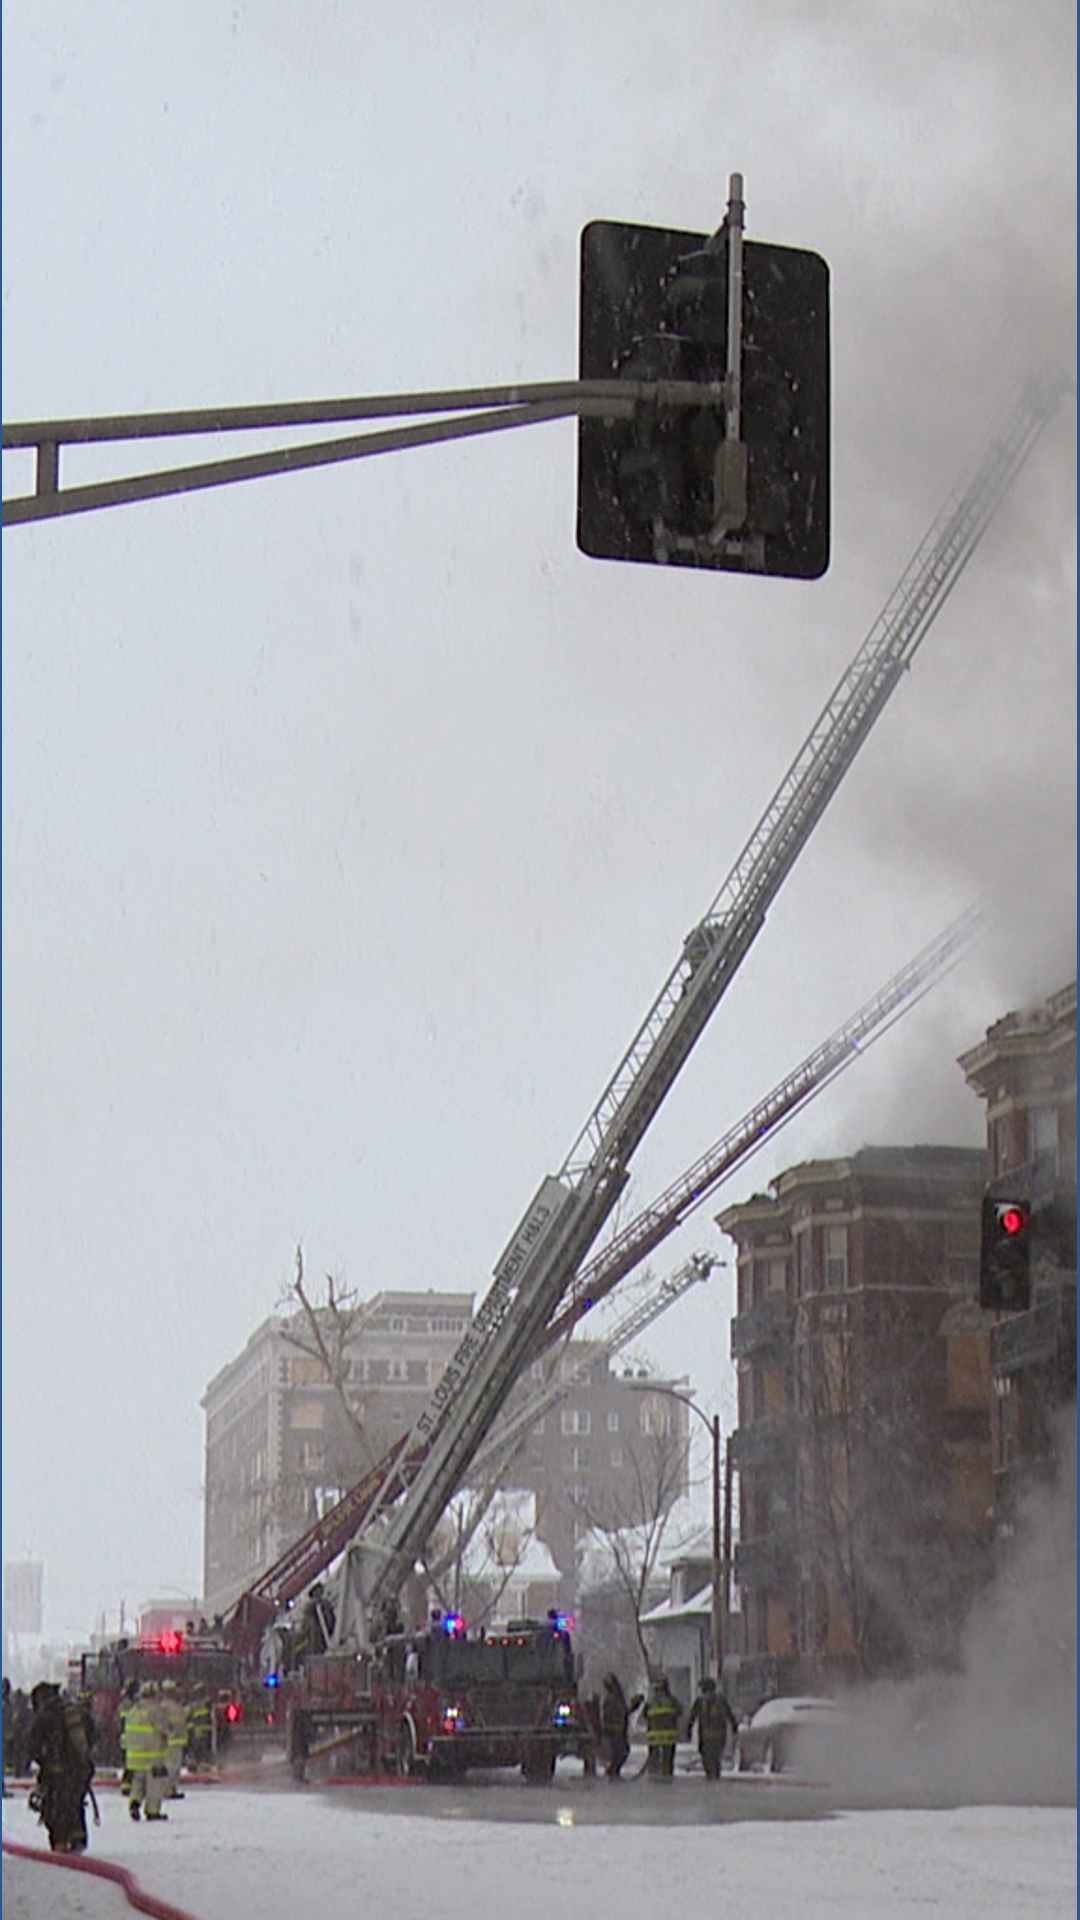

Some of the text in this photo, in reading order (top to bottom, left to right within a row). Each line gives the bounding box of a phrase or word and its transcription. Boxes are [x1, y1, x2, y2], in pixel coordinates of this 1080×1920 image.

[417, 1411, 437, 1434] ST.
[431, 1367, 460, 1409] LOUIS
[454, 1333, 479, 1366] FIRE
[472, 1244, 525, 1332] DEPARTMENT
